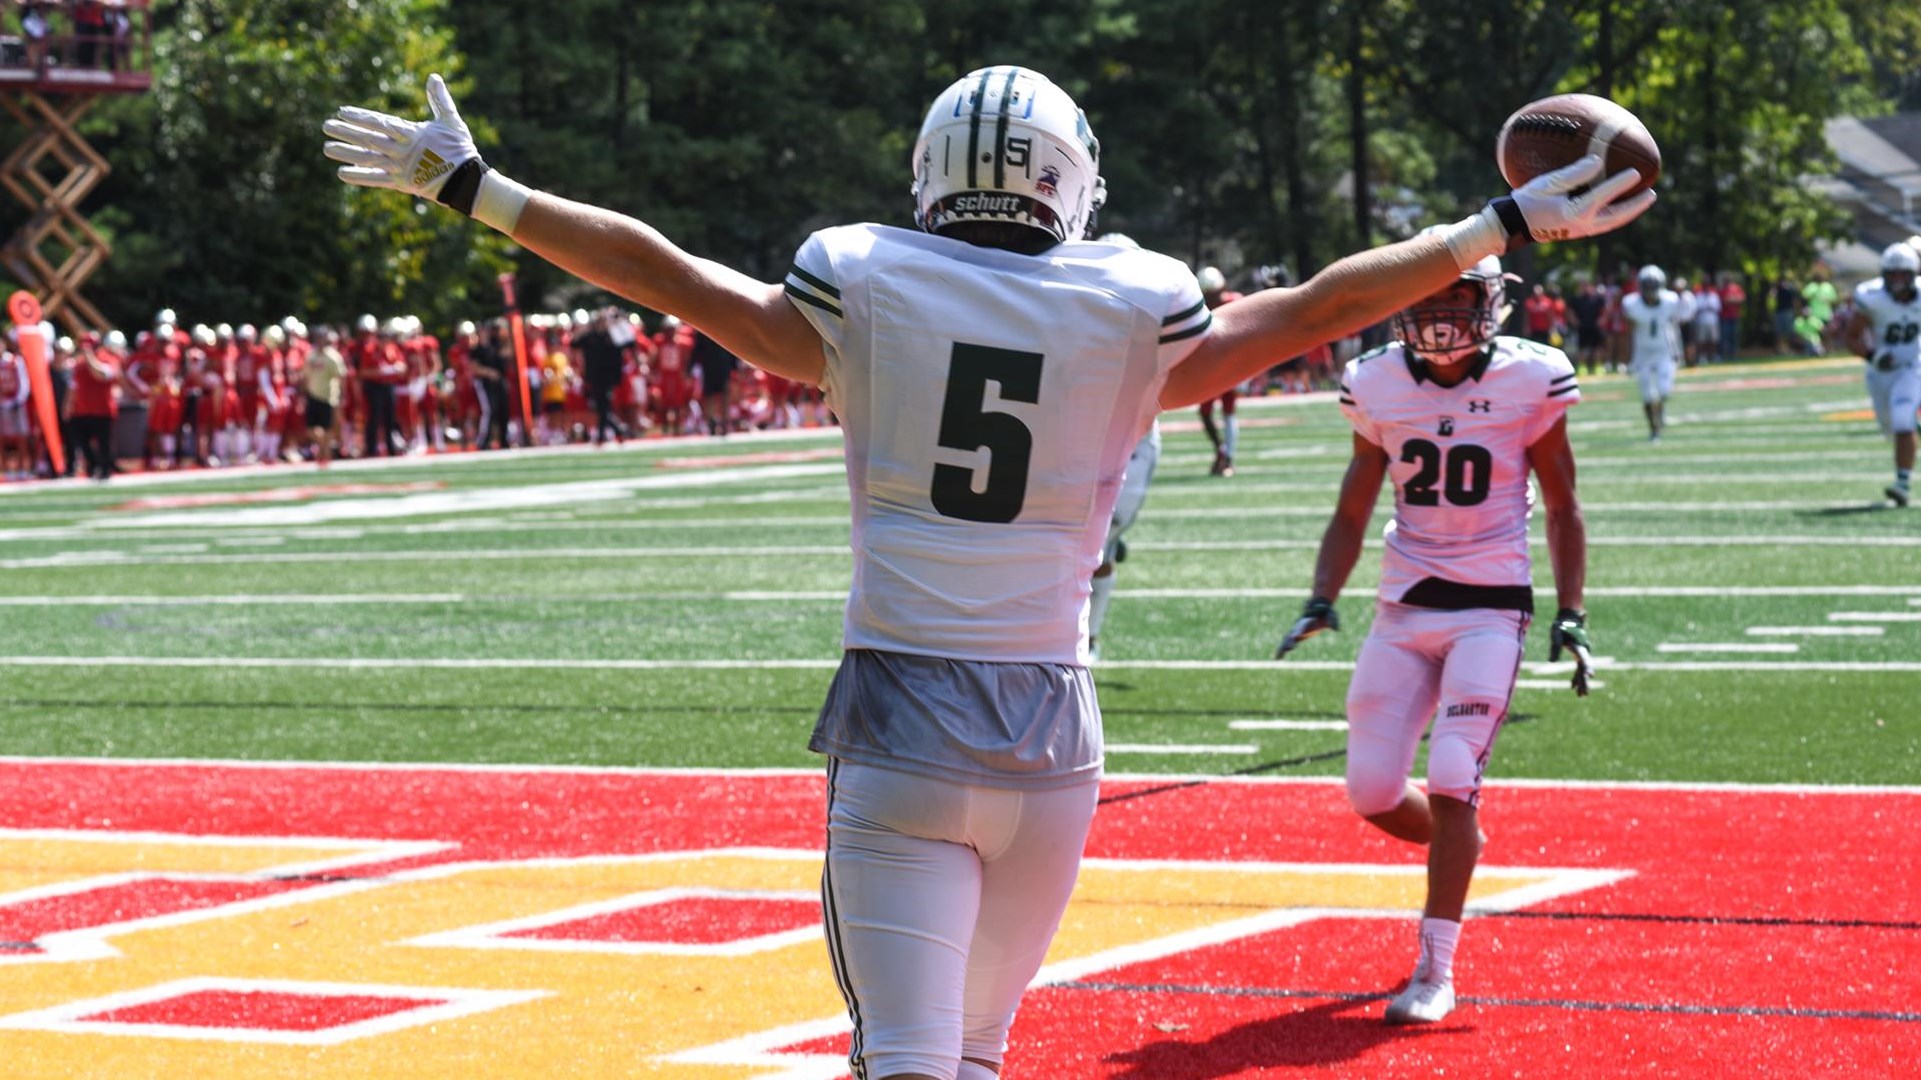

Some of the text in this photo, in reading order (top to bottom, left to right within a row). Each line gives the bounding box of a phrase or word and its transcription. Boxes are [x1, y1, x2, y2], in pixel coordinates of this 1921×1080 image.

[954, 192, 1021, 213] schutt
[931, 341, 1045, 523] 5
[1400, 438, 1492, 506] 20
